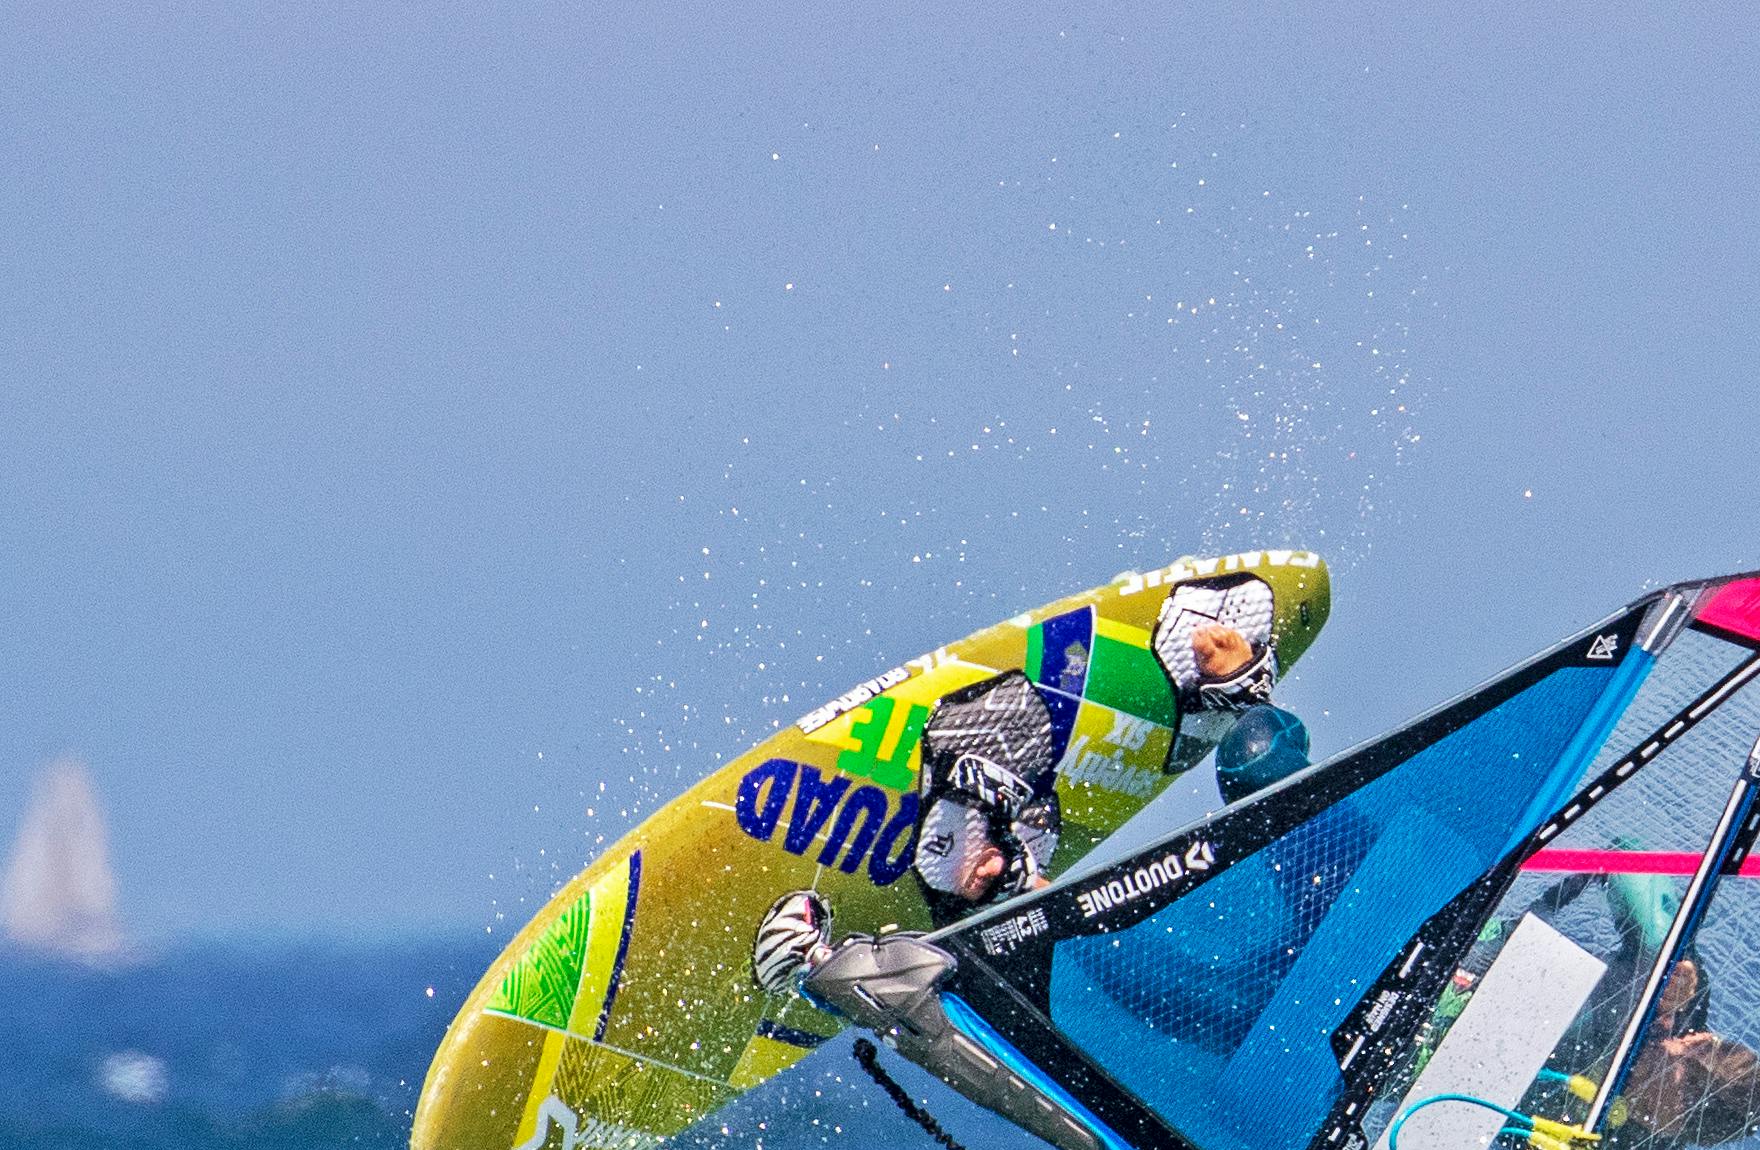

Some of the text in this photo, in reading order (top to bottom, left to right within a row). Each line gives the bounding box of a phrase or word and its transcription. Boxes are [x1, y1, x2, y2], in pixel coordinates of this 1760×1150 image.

[836, 695, 930, 792] TE
[736, 758, 920, 886] QUAD
[1077, 854, 1184, 918] DUOTONE
